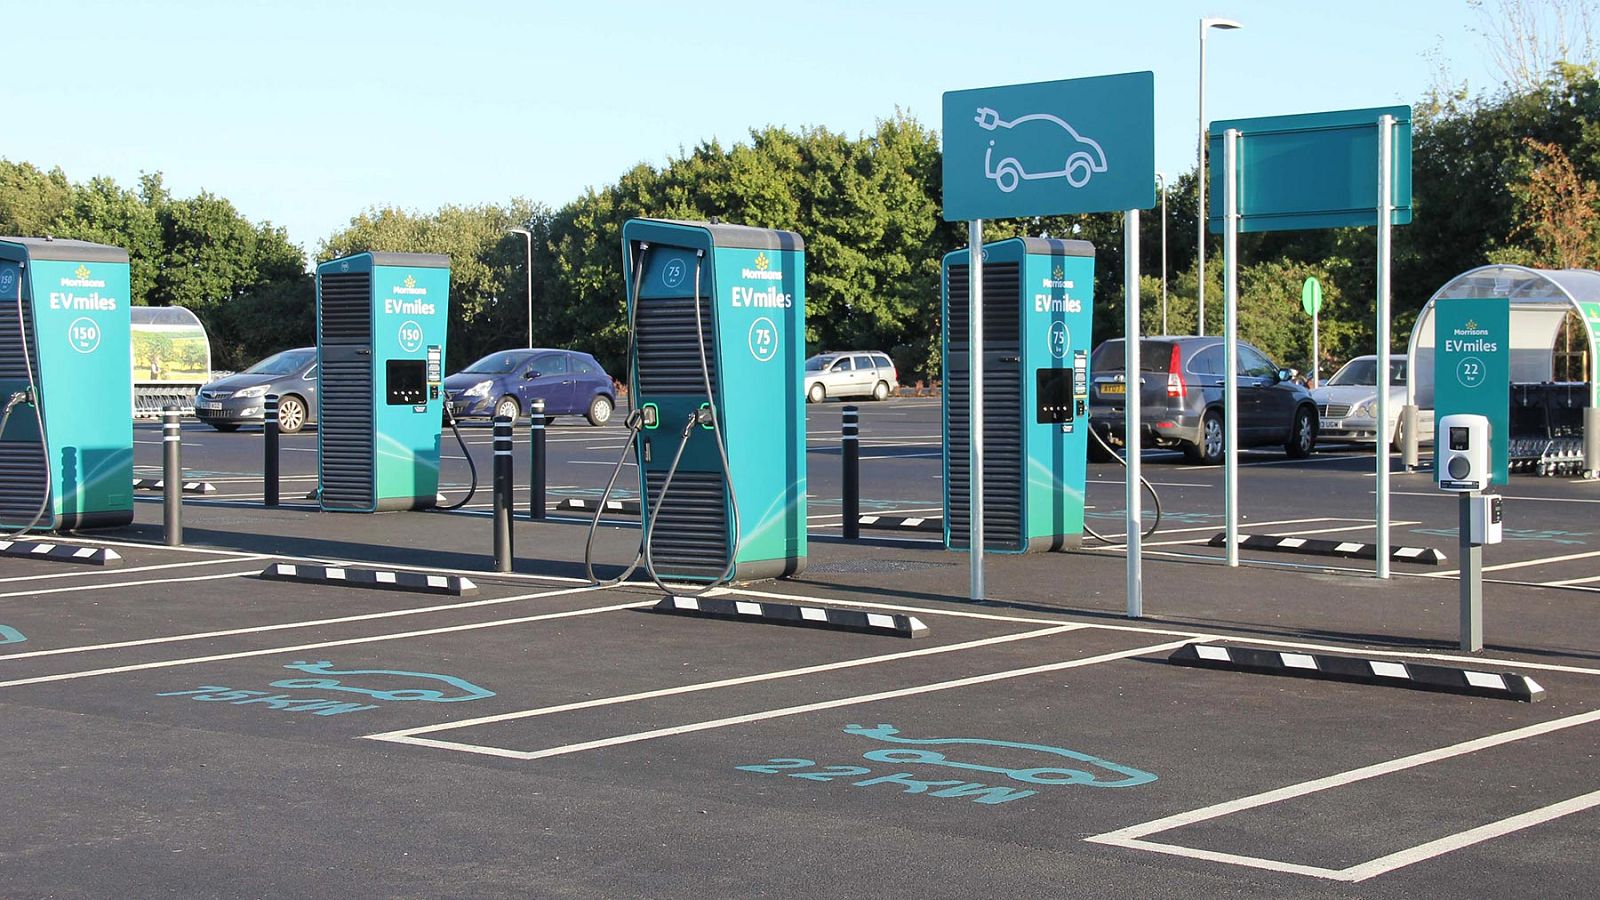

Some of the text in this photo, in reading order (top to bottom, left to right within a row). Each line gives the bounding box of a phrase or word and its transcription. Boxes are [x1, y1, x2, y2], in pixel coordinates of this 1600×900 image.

[668, 267, 680, 277] 75
[742, 268, 782, 280] Morrisons
[1, 275, 12, 284] 150
[61, 278, 105, 288] Morrisons
[1043, 279, 1074, 289] Morrisons
[393, 286, 427, 295] Morrisons
[732, 286, 792, 308] EVmiles
[50, 292, 116, 310] EVmiles
[385, 299, 435, 315] EVmiles
[1035, 294, 1082, 313] EVmiles
[73, 327, 96, 340] 150
[401, 328, 420, 341] 150
[756, 330, 771, 345] 75
[1053, 331, 1065, 344] 75
[1445, 339, 1497, 352] EVmiles
[1464, 363, 1478, 375] 22
